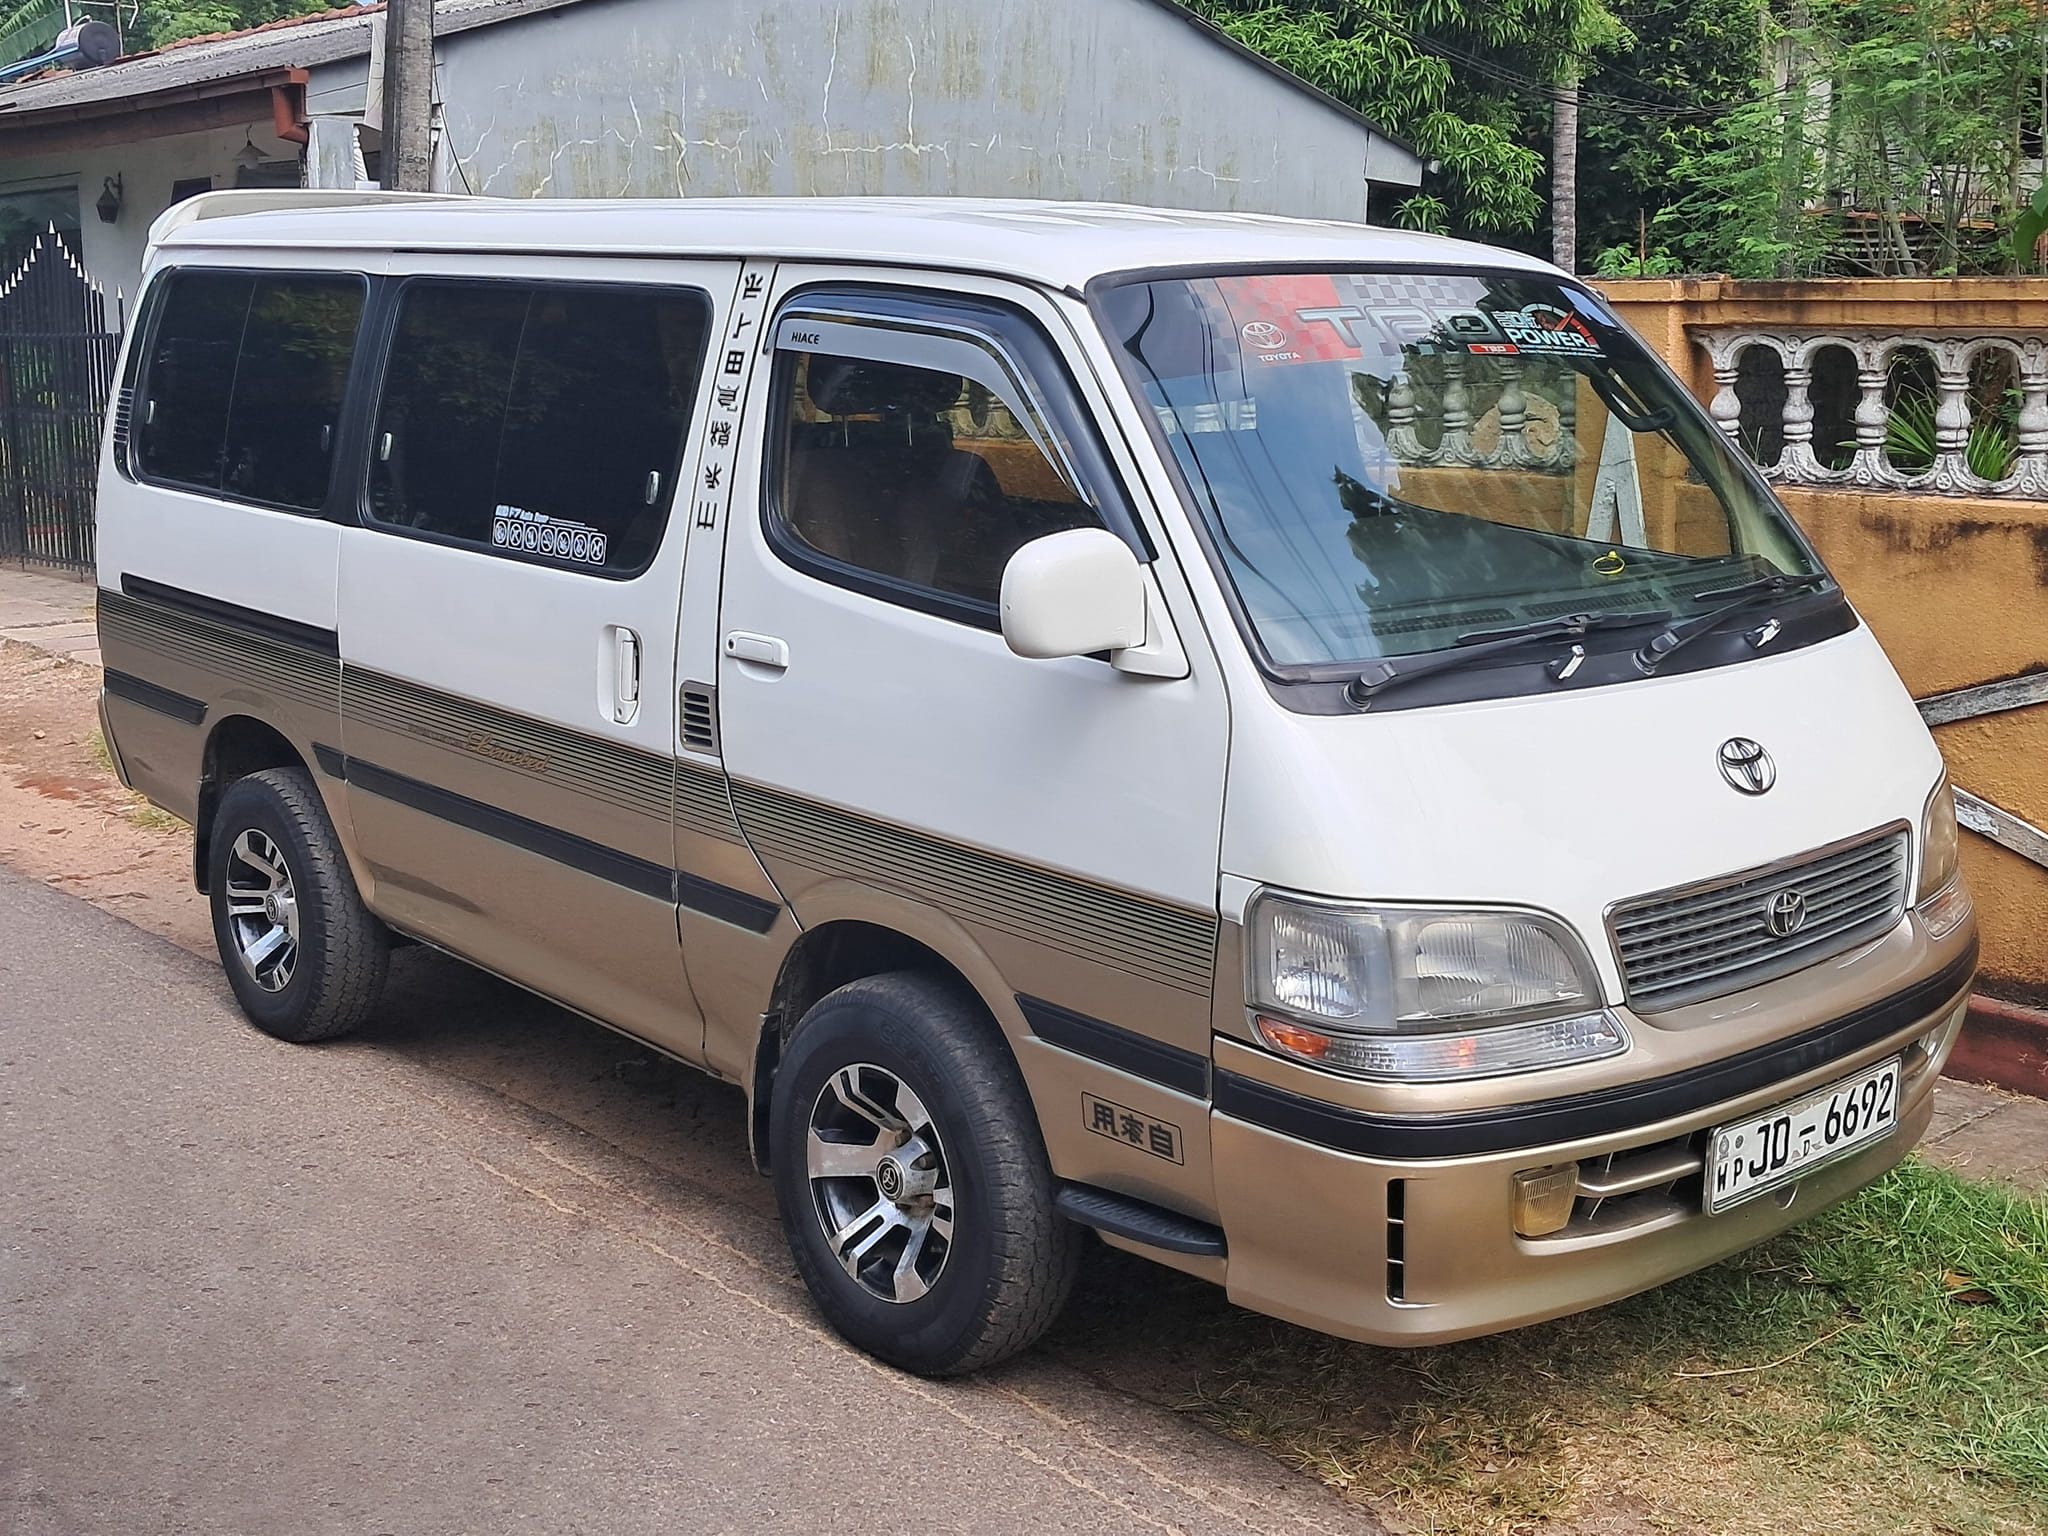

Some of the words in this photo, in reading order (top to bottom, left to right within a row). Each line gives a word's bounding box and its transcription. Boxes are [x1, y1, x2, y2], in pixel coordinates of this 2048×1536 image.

[791, 331, 821, 345] HIACE
[1504, 328, 1590, 348] POWER
[1257, 352, 1301, 362] TOYOTA
